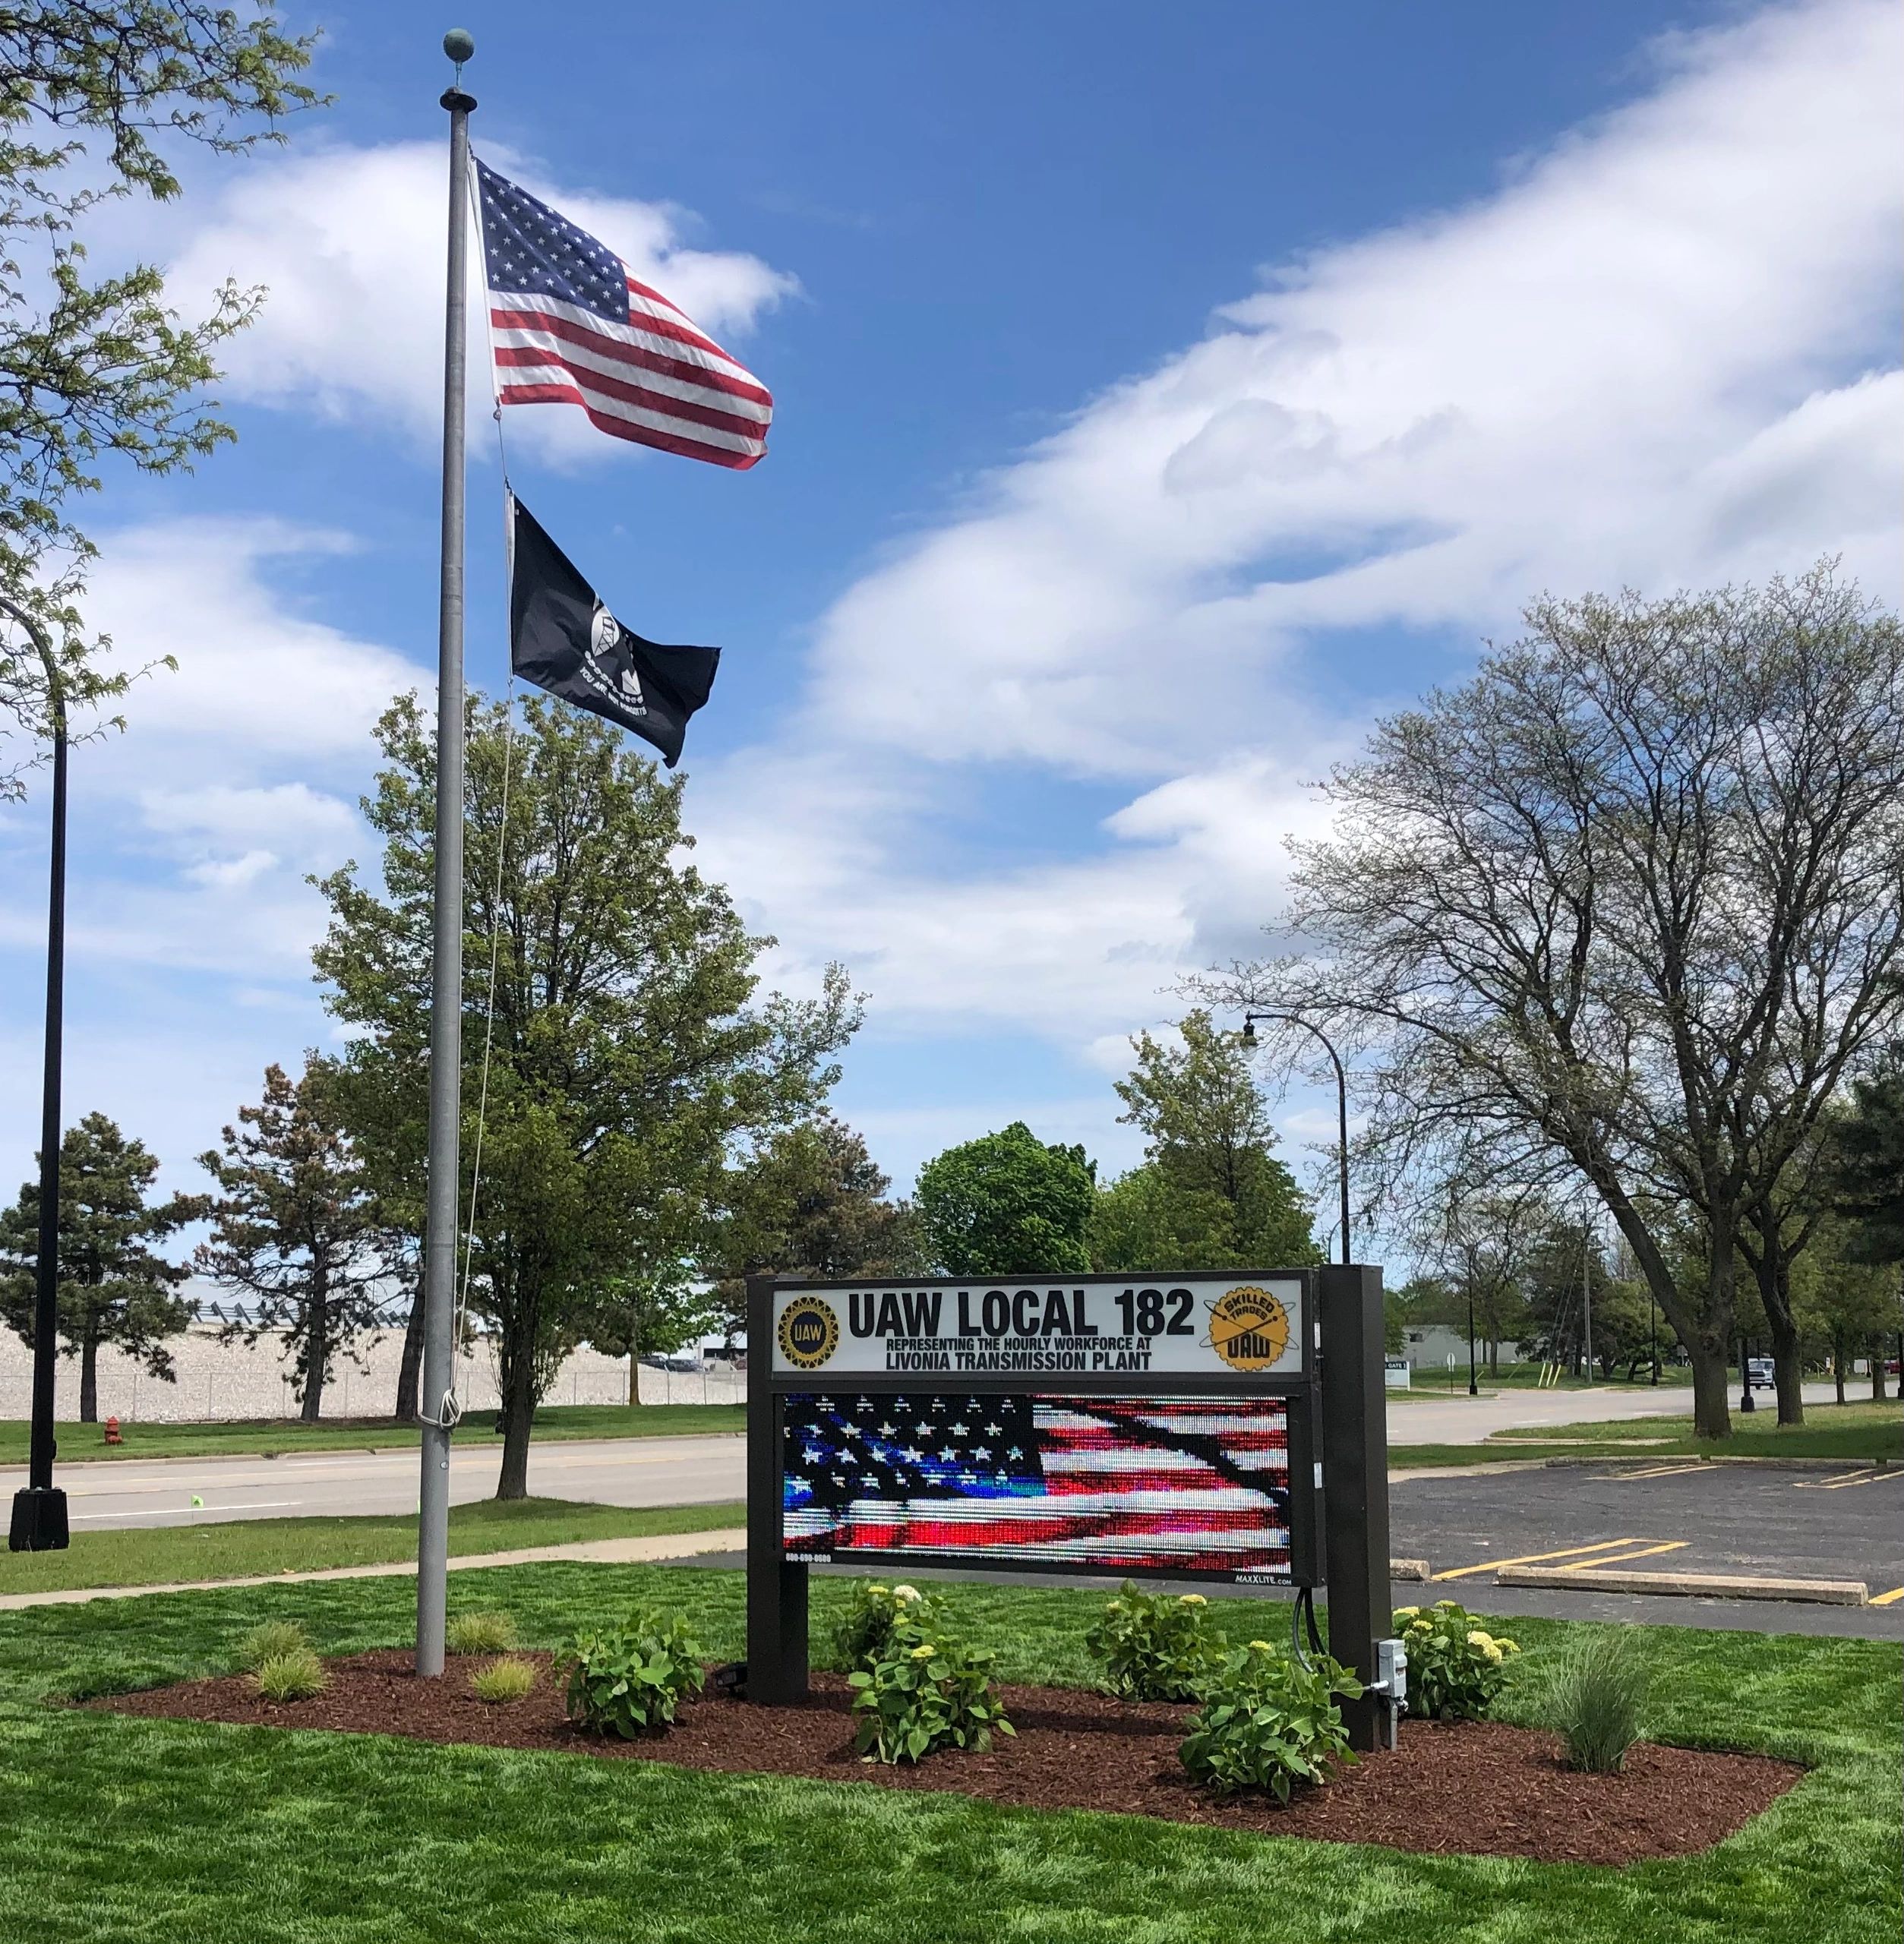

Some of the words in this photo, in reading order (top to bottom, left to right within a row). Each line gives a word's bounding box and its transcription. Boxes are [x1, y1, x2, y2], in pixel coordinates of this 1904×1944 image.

[579, 666, 595, 683] YOU
[1224, 1293, 1275, 1314] SKILLED
[848, 1292, 943, 1338] UAW
[958, 1289, 1098, 1337] LOCAL
[1114, 1288, 1195, 1336] 182
[1230, 1305, 1268, 1321] TRADES
[794, 1324, 823, 1341] UAW
[886, 1338, 974, 1352] REPRESENTING
[977, 1337, 1000, 1351] THE
[1004, 1337, 1051, 1351] HOURLY
[1054, 1337, 1133, 1350] WORKFORCE
[1136, 1337, 1152, 1350] AT
[1227, 1333, 1271, 1359] UAW
[886, 1352, 951, 1371] LIVONIA
[955, 1352, 1086, 1371] TRANSMISSION
[1092, 1352, 1152, 1371] PLANT
